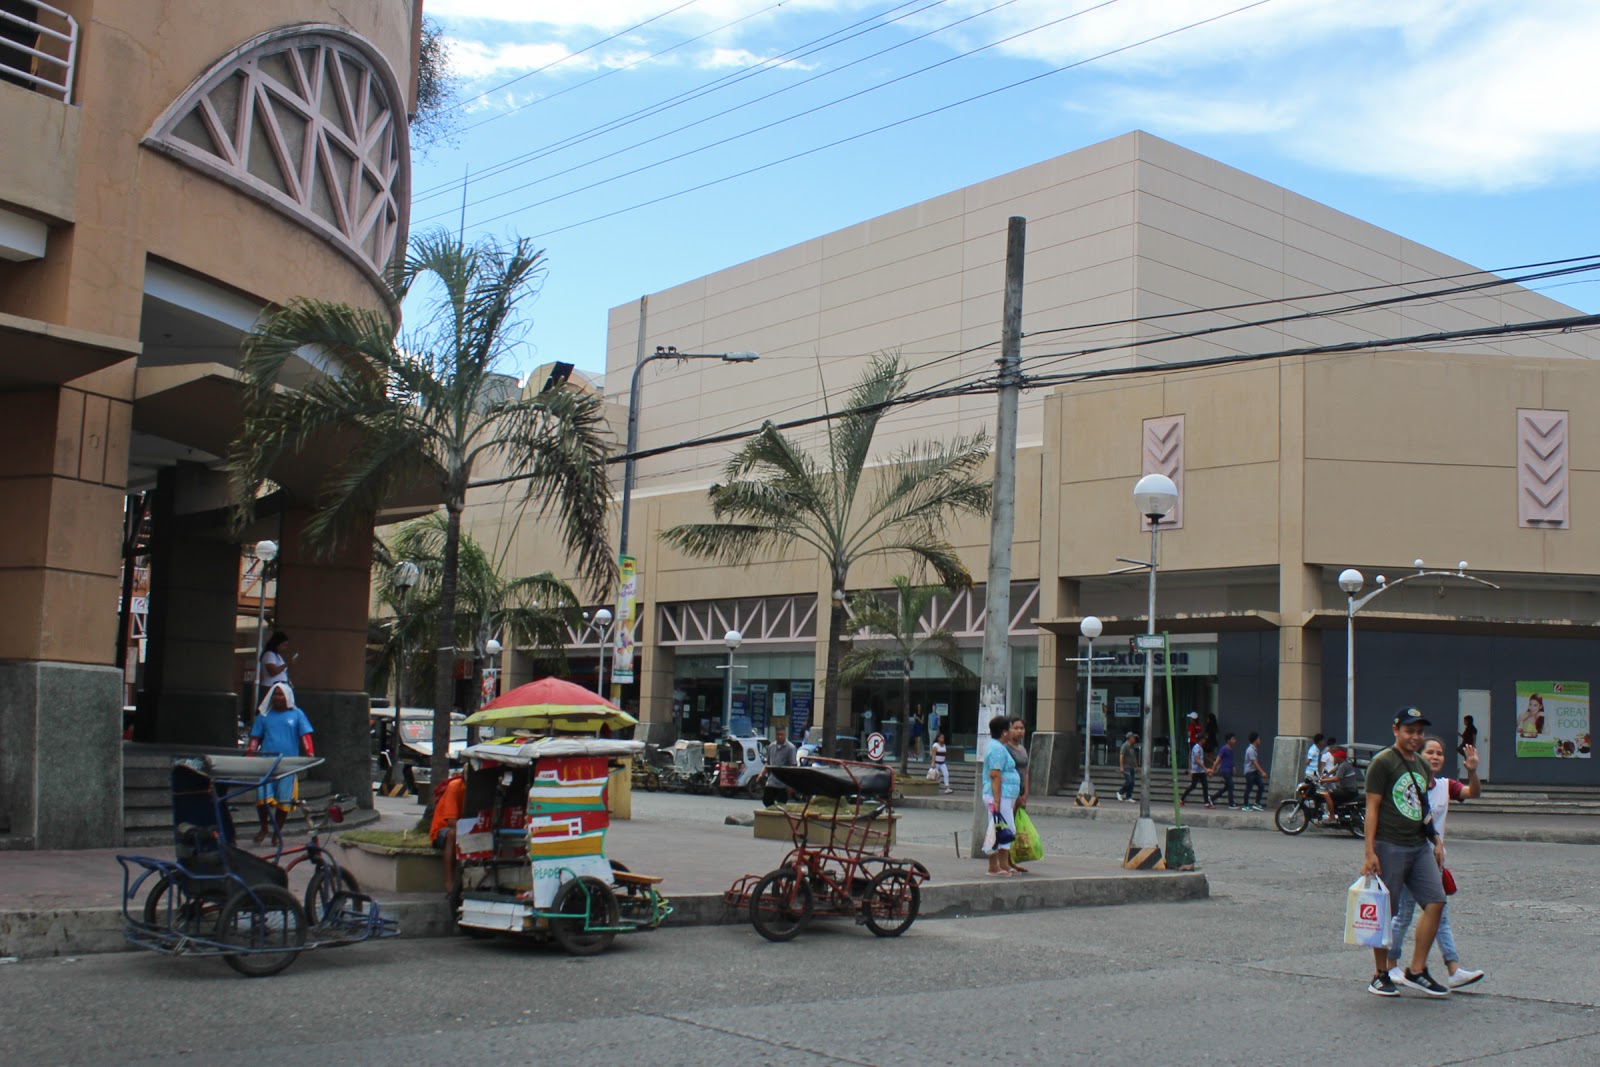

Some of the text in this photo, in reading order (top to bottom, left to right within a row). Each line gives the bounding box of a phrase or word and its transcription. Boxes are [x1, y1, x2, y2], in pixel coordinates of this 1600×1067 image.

[1556, 707, 1587, 717] GREAT
[1558, 719, 1587, 729] FOOD
[873, 739, 880, 754] P
